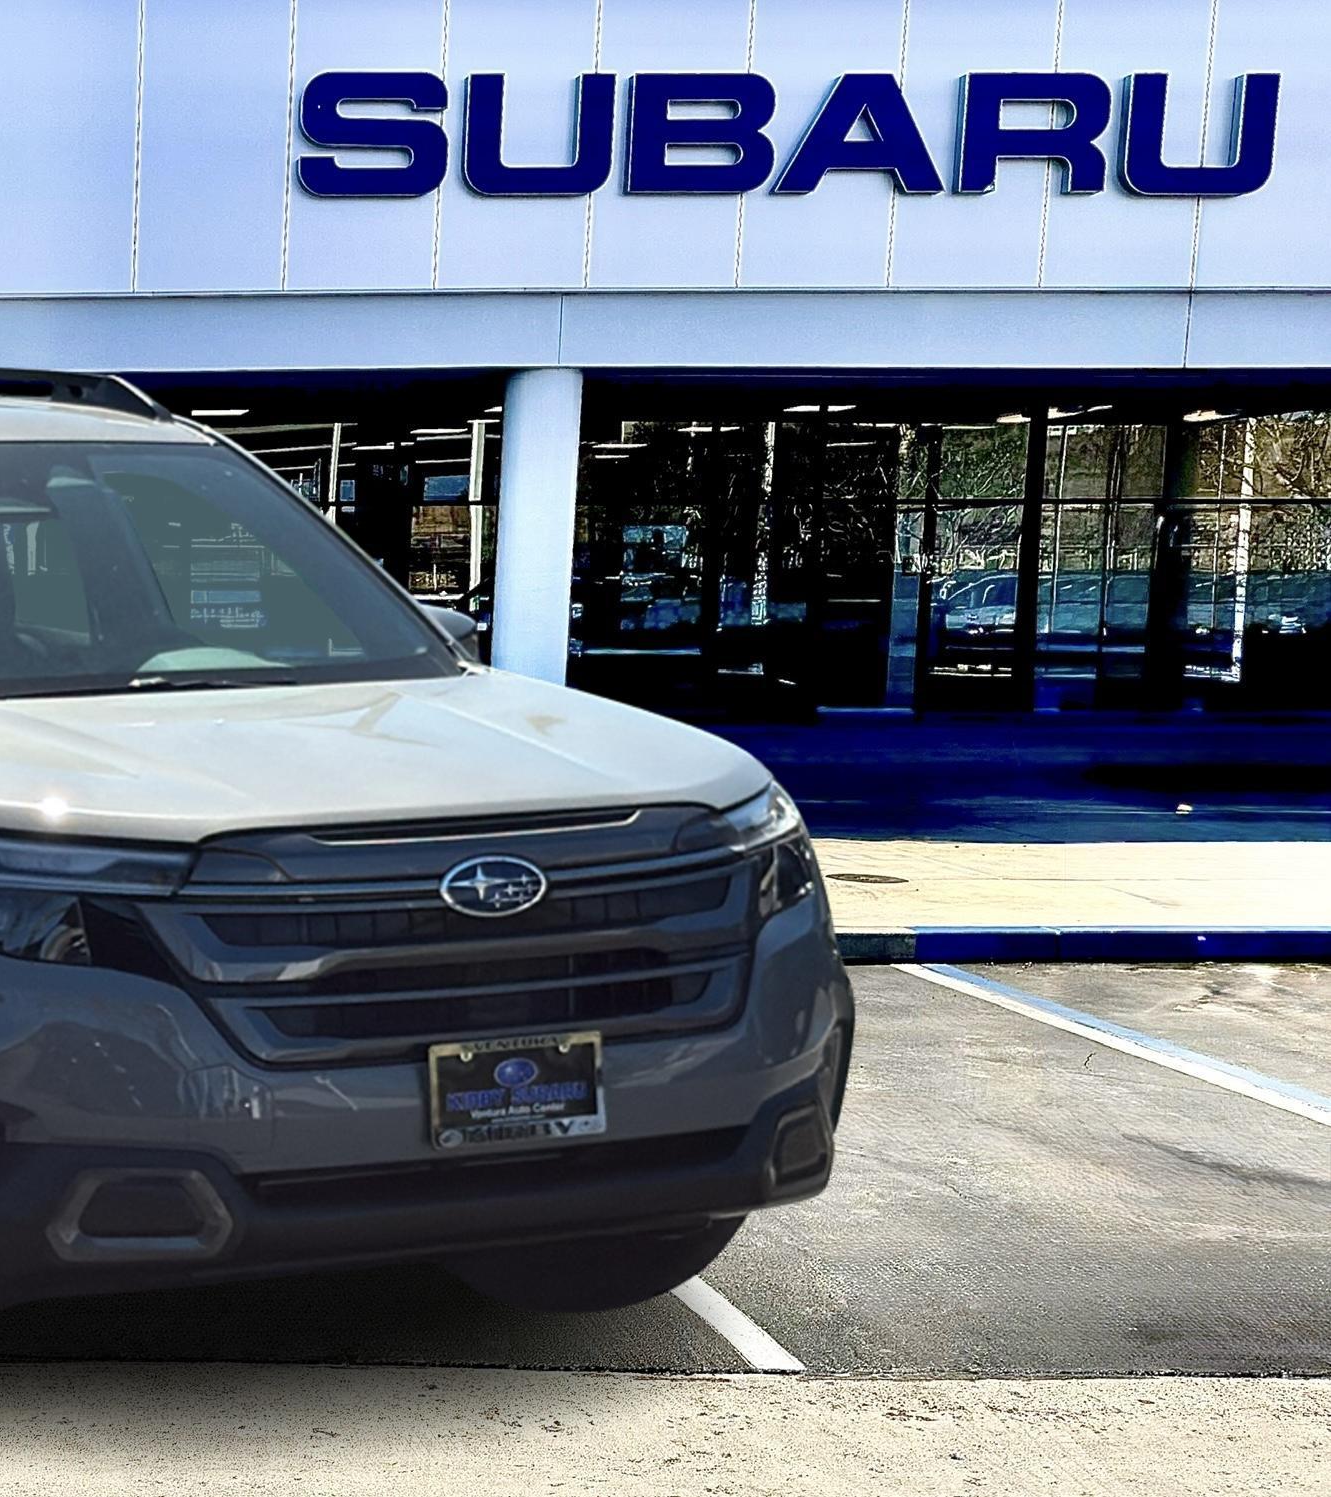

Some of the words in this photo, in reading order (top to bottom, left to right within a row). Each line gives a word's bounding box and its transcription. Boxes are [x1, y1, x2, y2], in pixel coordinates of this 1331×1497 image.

[295, 69, 1283, 198] SUBARU
[470, 1108, 506, 1120] Ventura
[508, 1104, 531, 1116] Auto
[532, 1101, 566, 1113] Center
